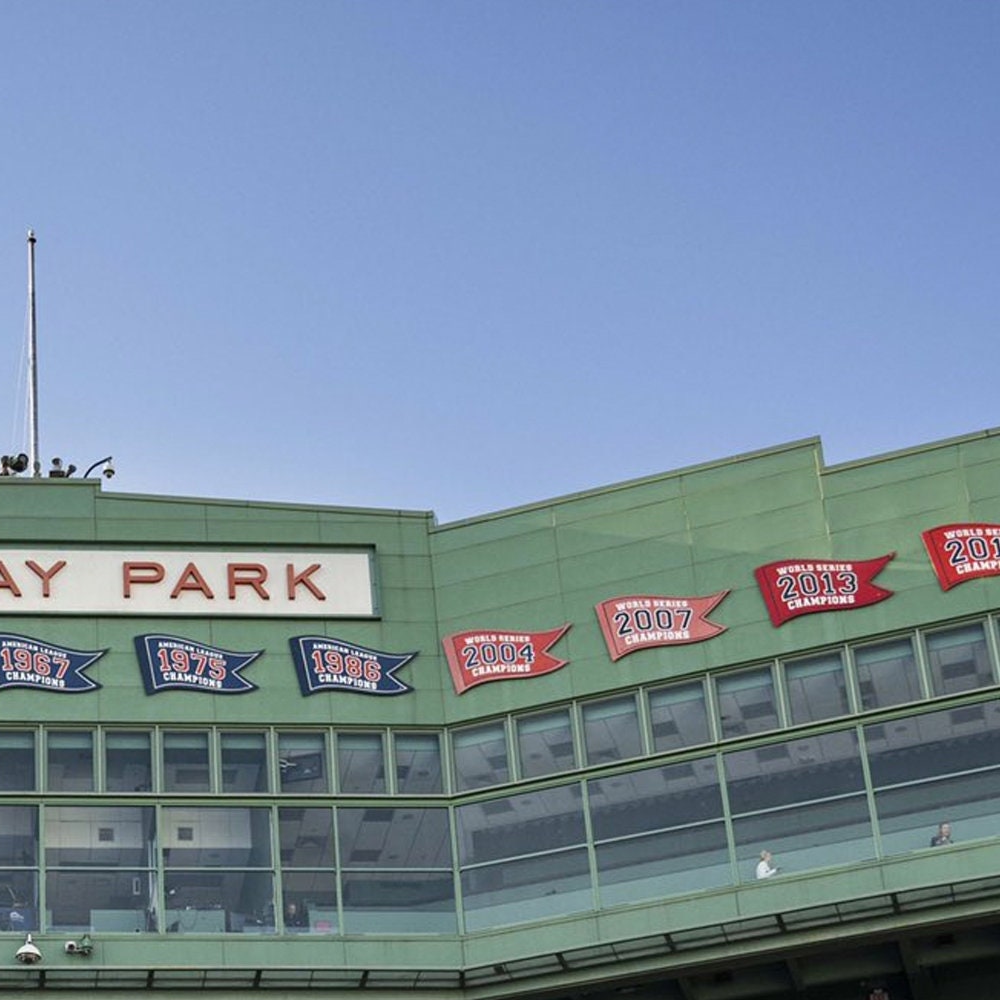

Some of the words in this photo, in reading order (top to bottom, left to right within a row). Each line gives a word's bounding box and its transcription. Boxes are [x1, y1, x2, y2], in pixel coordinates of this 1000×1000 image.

[943, 528, 983, 539] WORLD
[776, 564, 814, 575] WORLD
[816, 564, 853, 572] SERIES
[122, 561, 327, 600] PARK
[777, 572, 858, 602] 2013
[615, 600, 652, 611] WORLD
[787, 595, 855, 610] CHAMPIONS
[614, 608, 693, 638] 2007
[464, 635, 497, 644] WORLD
[625, 631, 690, 645] CHAMPIONS
[1, 641, 38, 652] AMERICAN
[40, 646, 67, 658] LEAGUE
[158, 642, 195, 652] AMERICAN
[196, 647, 223, 659] LEAGUE
[313, 643, 349, 654] AMERICAN
[350, 649, 378, 660] LEAGUE
[462, 643, 535, 668] 2004
[0, 647, 70, 679] 1967
[157, 648, 227, 680] 1975
[312, 650, 381, 681] 1986
[471, 664, 530, 677] CHAMPIONS
[5, 671, 65, 688] CHAMPIONS
[163, 672, 222, 688] CHAMPIONS
[318, 674, 378, 690] CHAMPIONS
